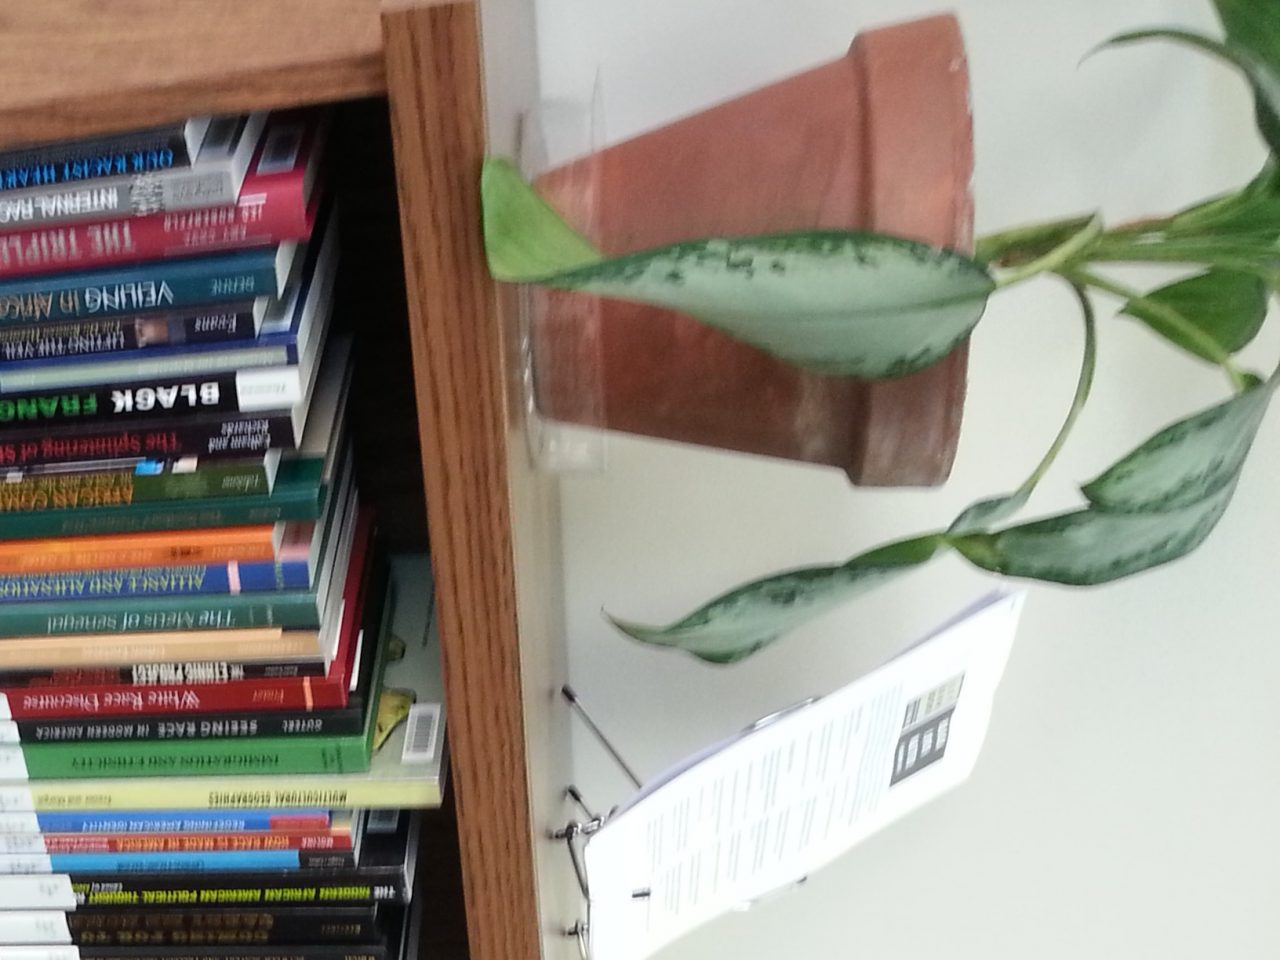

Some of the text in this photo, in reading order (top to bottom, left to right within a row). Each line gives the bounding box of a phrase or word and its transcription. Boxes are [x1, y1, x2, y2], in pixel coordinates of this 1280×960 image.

[35, 187, 118, 219] INTERNAL
[87, 220, 133, 255] THE
[84, 280, 174, 312] VEILING
[6, 340, 35, 360] VEIL
[111, 382, 220, 412] BLACK
[20, 443, 38, 460] of
[41, 434, 141, 458] Splintering
[147, 432, 177, 451] The
[52, 485, 133, 508] AFRICAN
[120, 611, 140, 632] of
[199, 609, 235, 629] The
[131, 663, 183, 686] PROJECT
[182, 661, 228, 685] ETHNIC
[23, 689, 200, 714] White Race Discourse
[36, 719, 258, 740] SEEING RACE IN MODERN AMERICA
[188, 753, 279, 768] IMMIGRATION
[208, 790, 348, 810] MULTICULTURAL GEOGRAPHIES
[82, 818, 246, 833] REDEFINING AMERICAN IDENTITY
[116, 838, 165, 851] AMERICA
[182, 837, 214, 850] MADE
[230, 836, 262, 849] RACE
[266, 835, 289, 848] HOW
[88, 891, 139, 905] THOUGHT
[141, 889, 197, 904] POLITICAL
[200, 889, 262, 903] AMERICAN
[265, 887, 317, 902] AFRICAN
[373, 886, 396, 899] THE
